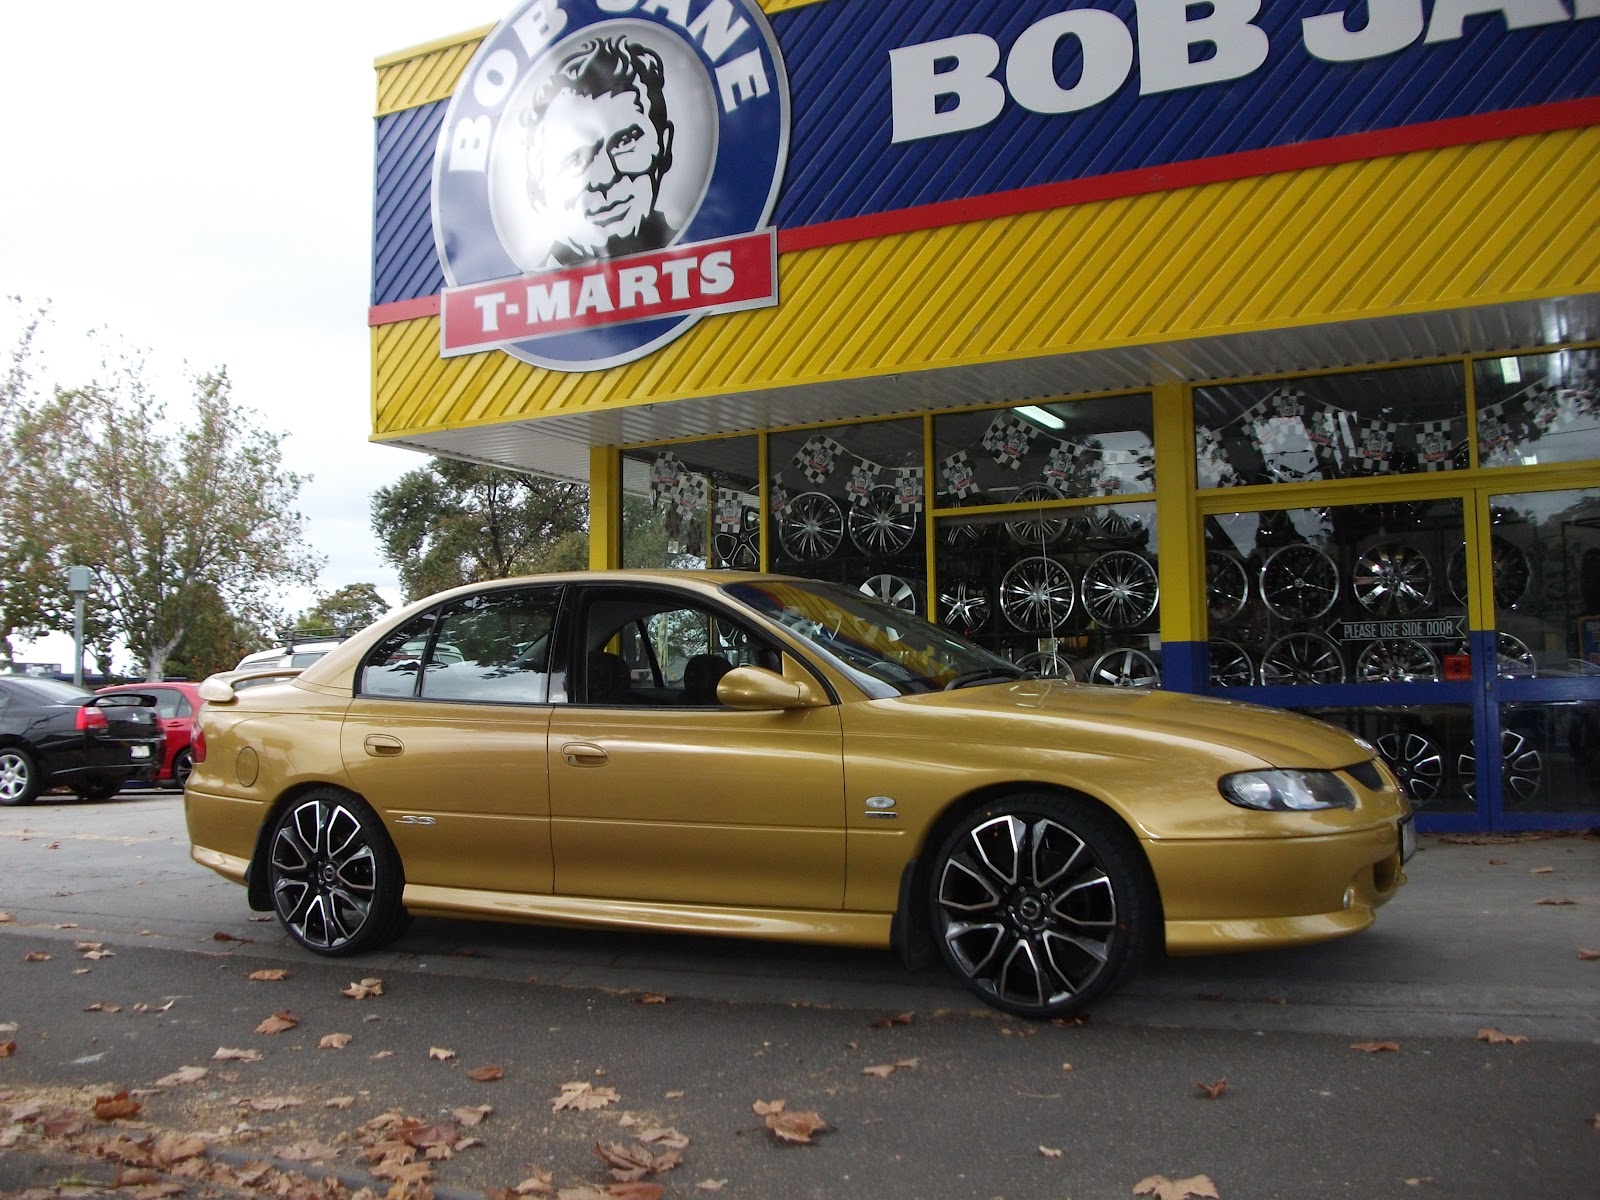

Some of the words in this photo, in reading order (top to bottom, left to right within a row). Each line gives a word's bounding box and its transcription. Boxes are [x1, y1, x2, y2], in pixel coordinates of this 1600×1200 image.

[449, 0, 569, 172] BOB
[889, 0, 1270, 144] BOB
[475, 250, 735, 332] T-MARTS
[1344, 623, 1377, 638] PLEASE
[1380, 622, 1399, 636] USE
[1402, 621, 1423, 636] SIDE
[1426, 620, 1453, 635] DOOR
